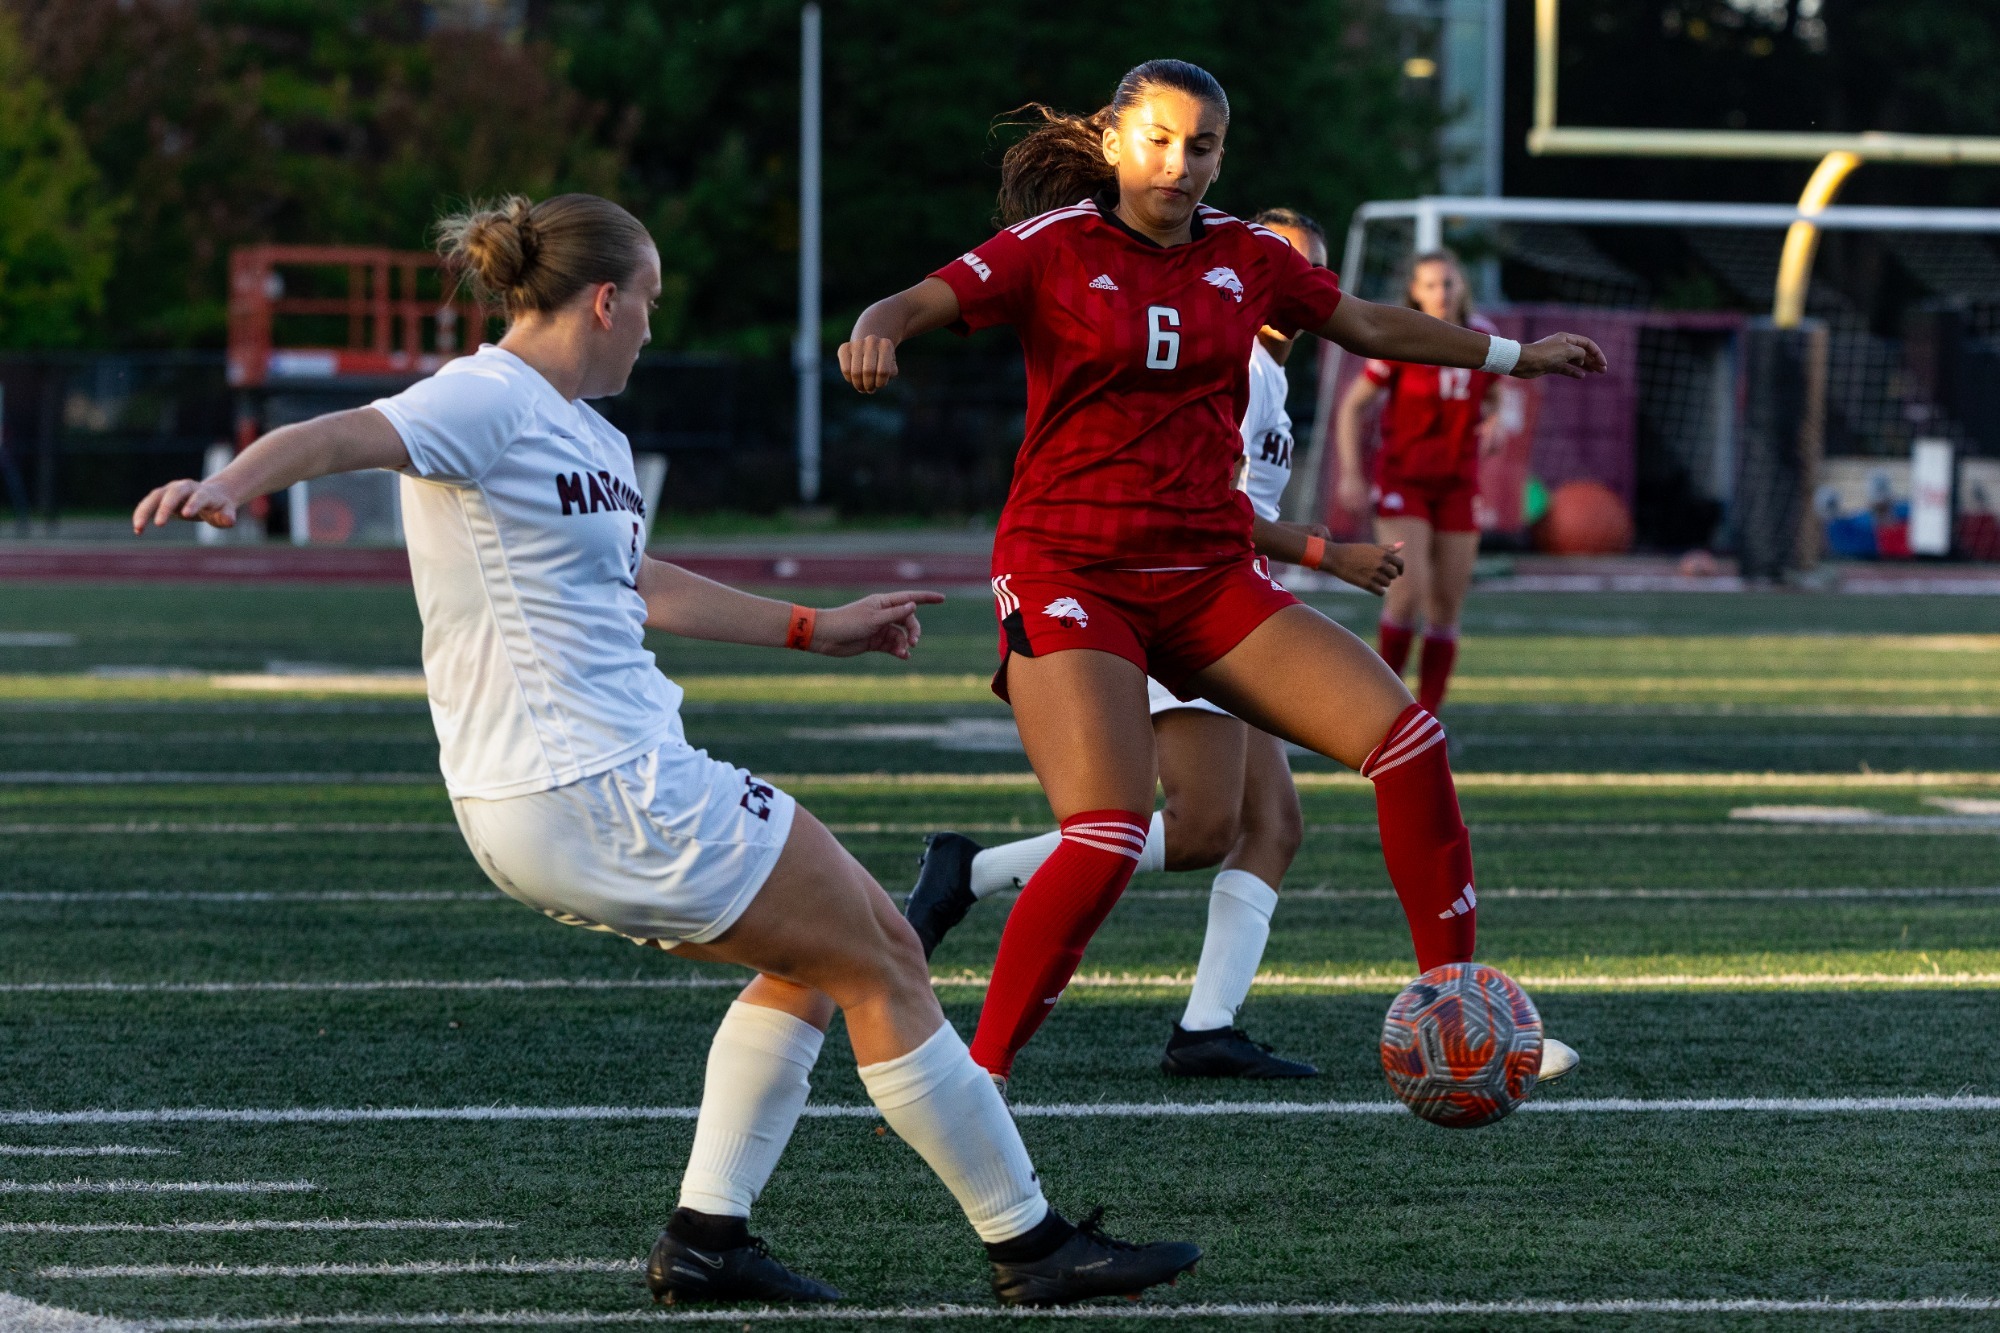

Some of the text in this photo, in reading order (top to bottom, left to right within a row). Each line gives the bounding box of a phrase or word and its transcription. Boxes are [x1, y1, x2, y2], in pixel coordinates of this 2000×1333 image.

[1089, 282, 1119, 291] adidas
[1146, 304, 1181, 372] 6
[1260, 431, 1293, 470] MA
